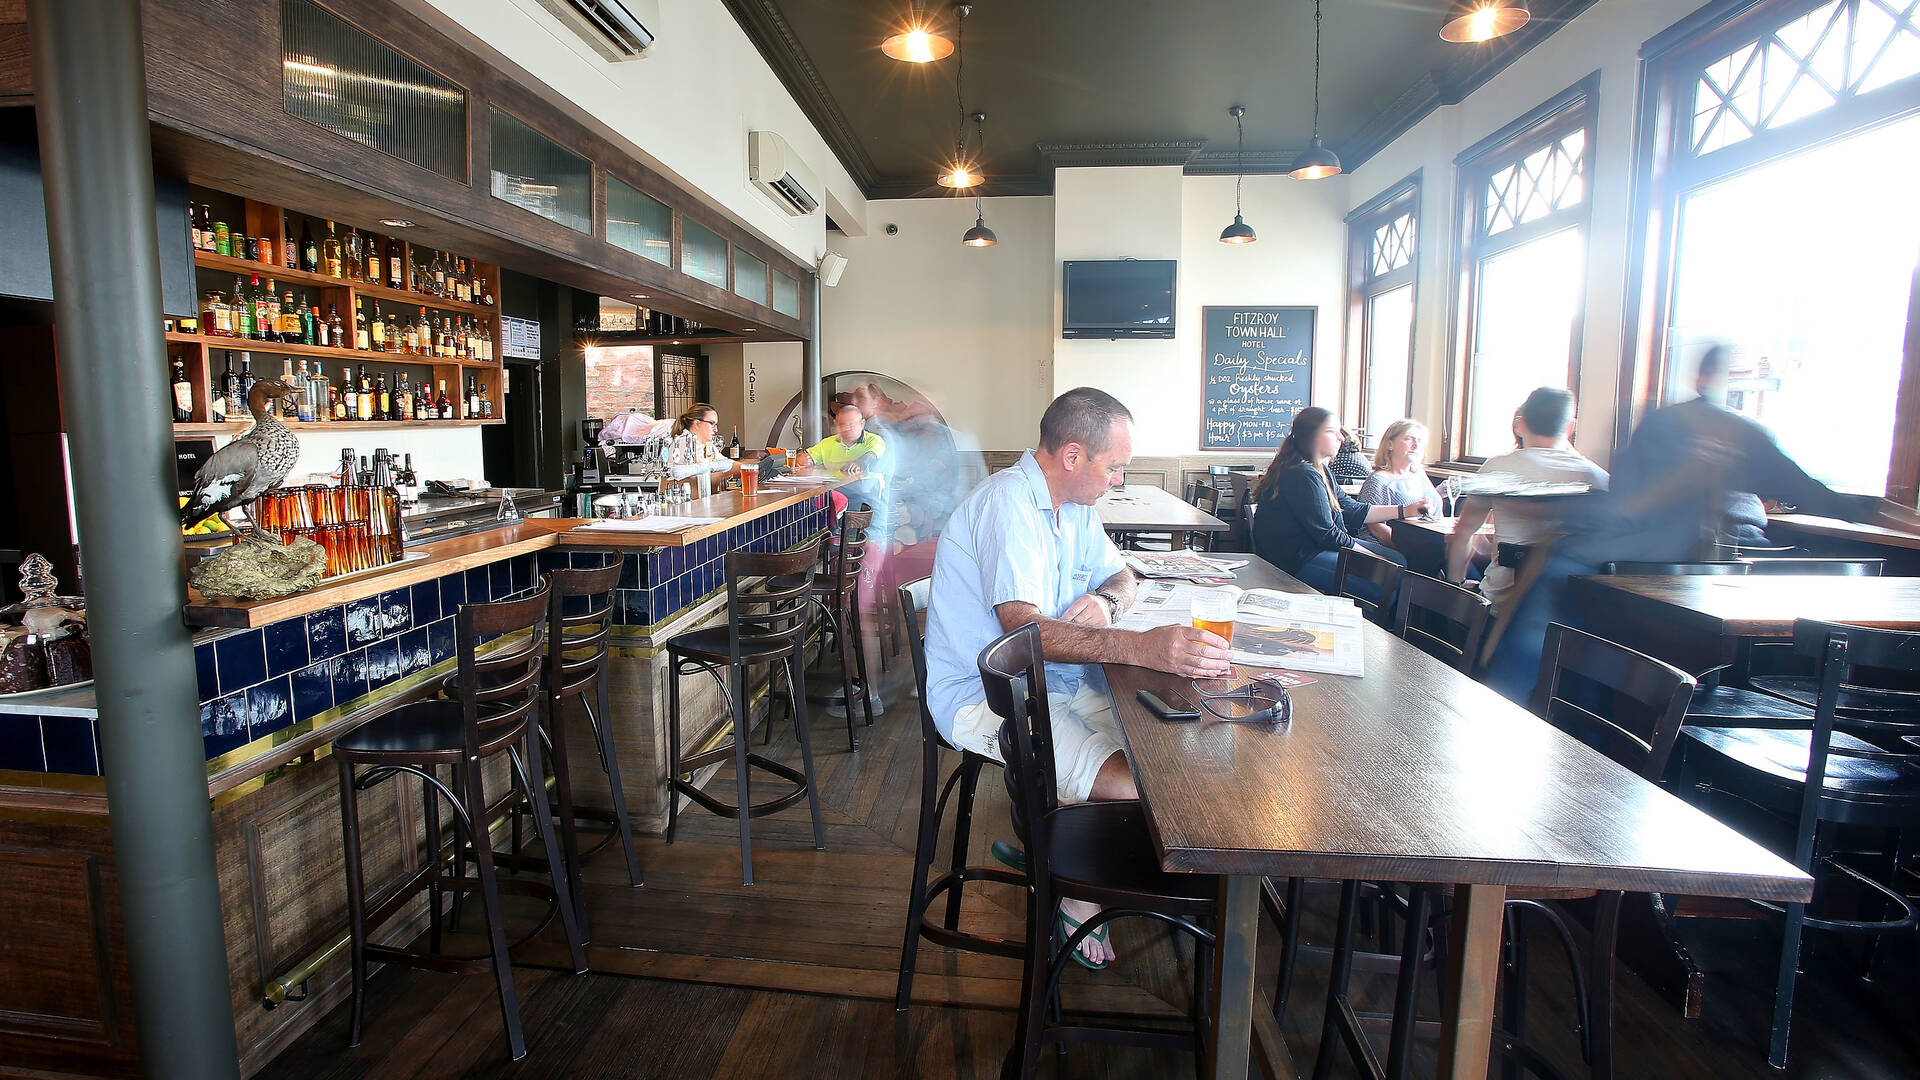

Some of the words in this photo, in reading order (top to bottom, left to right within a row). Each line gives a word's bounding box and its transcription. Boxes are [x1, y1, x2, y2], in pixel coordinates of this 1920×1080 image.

[1233, 312, 1279, 325] FITZROY
[1213, 351, 1250, 375] Daily
[1256, 349, 1307, 372] Specials
[1229, 382, 1279, 404] Oysters
[1206, 417, 1236, 436] Happy
[1208, 431, 1231, 445] Hour
